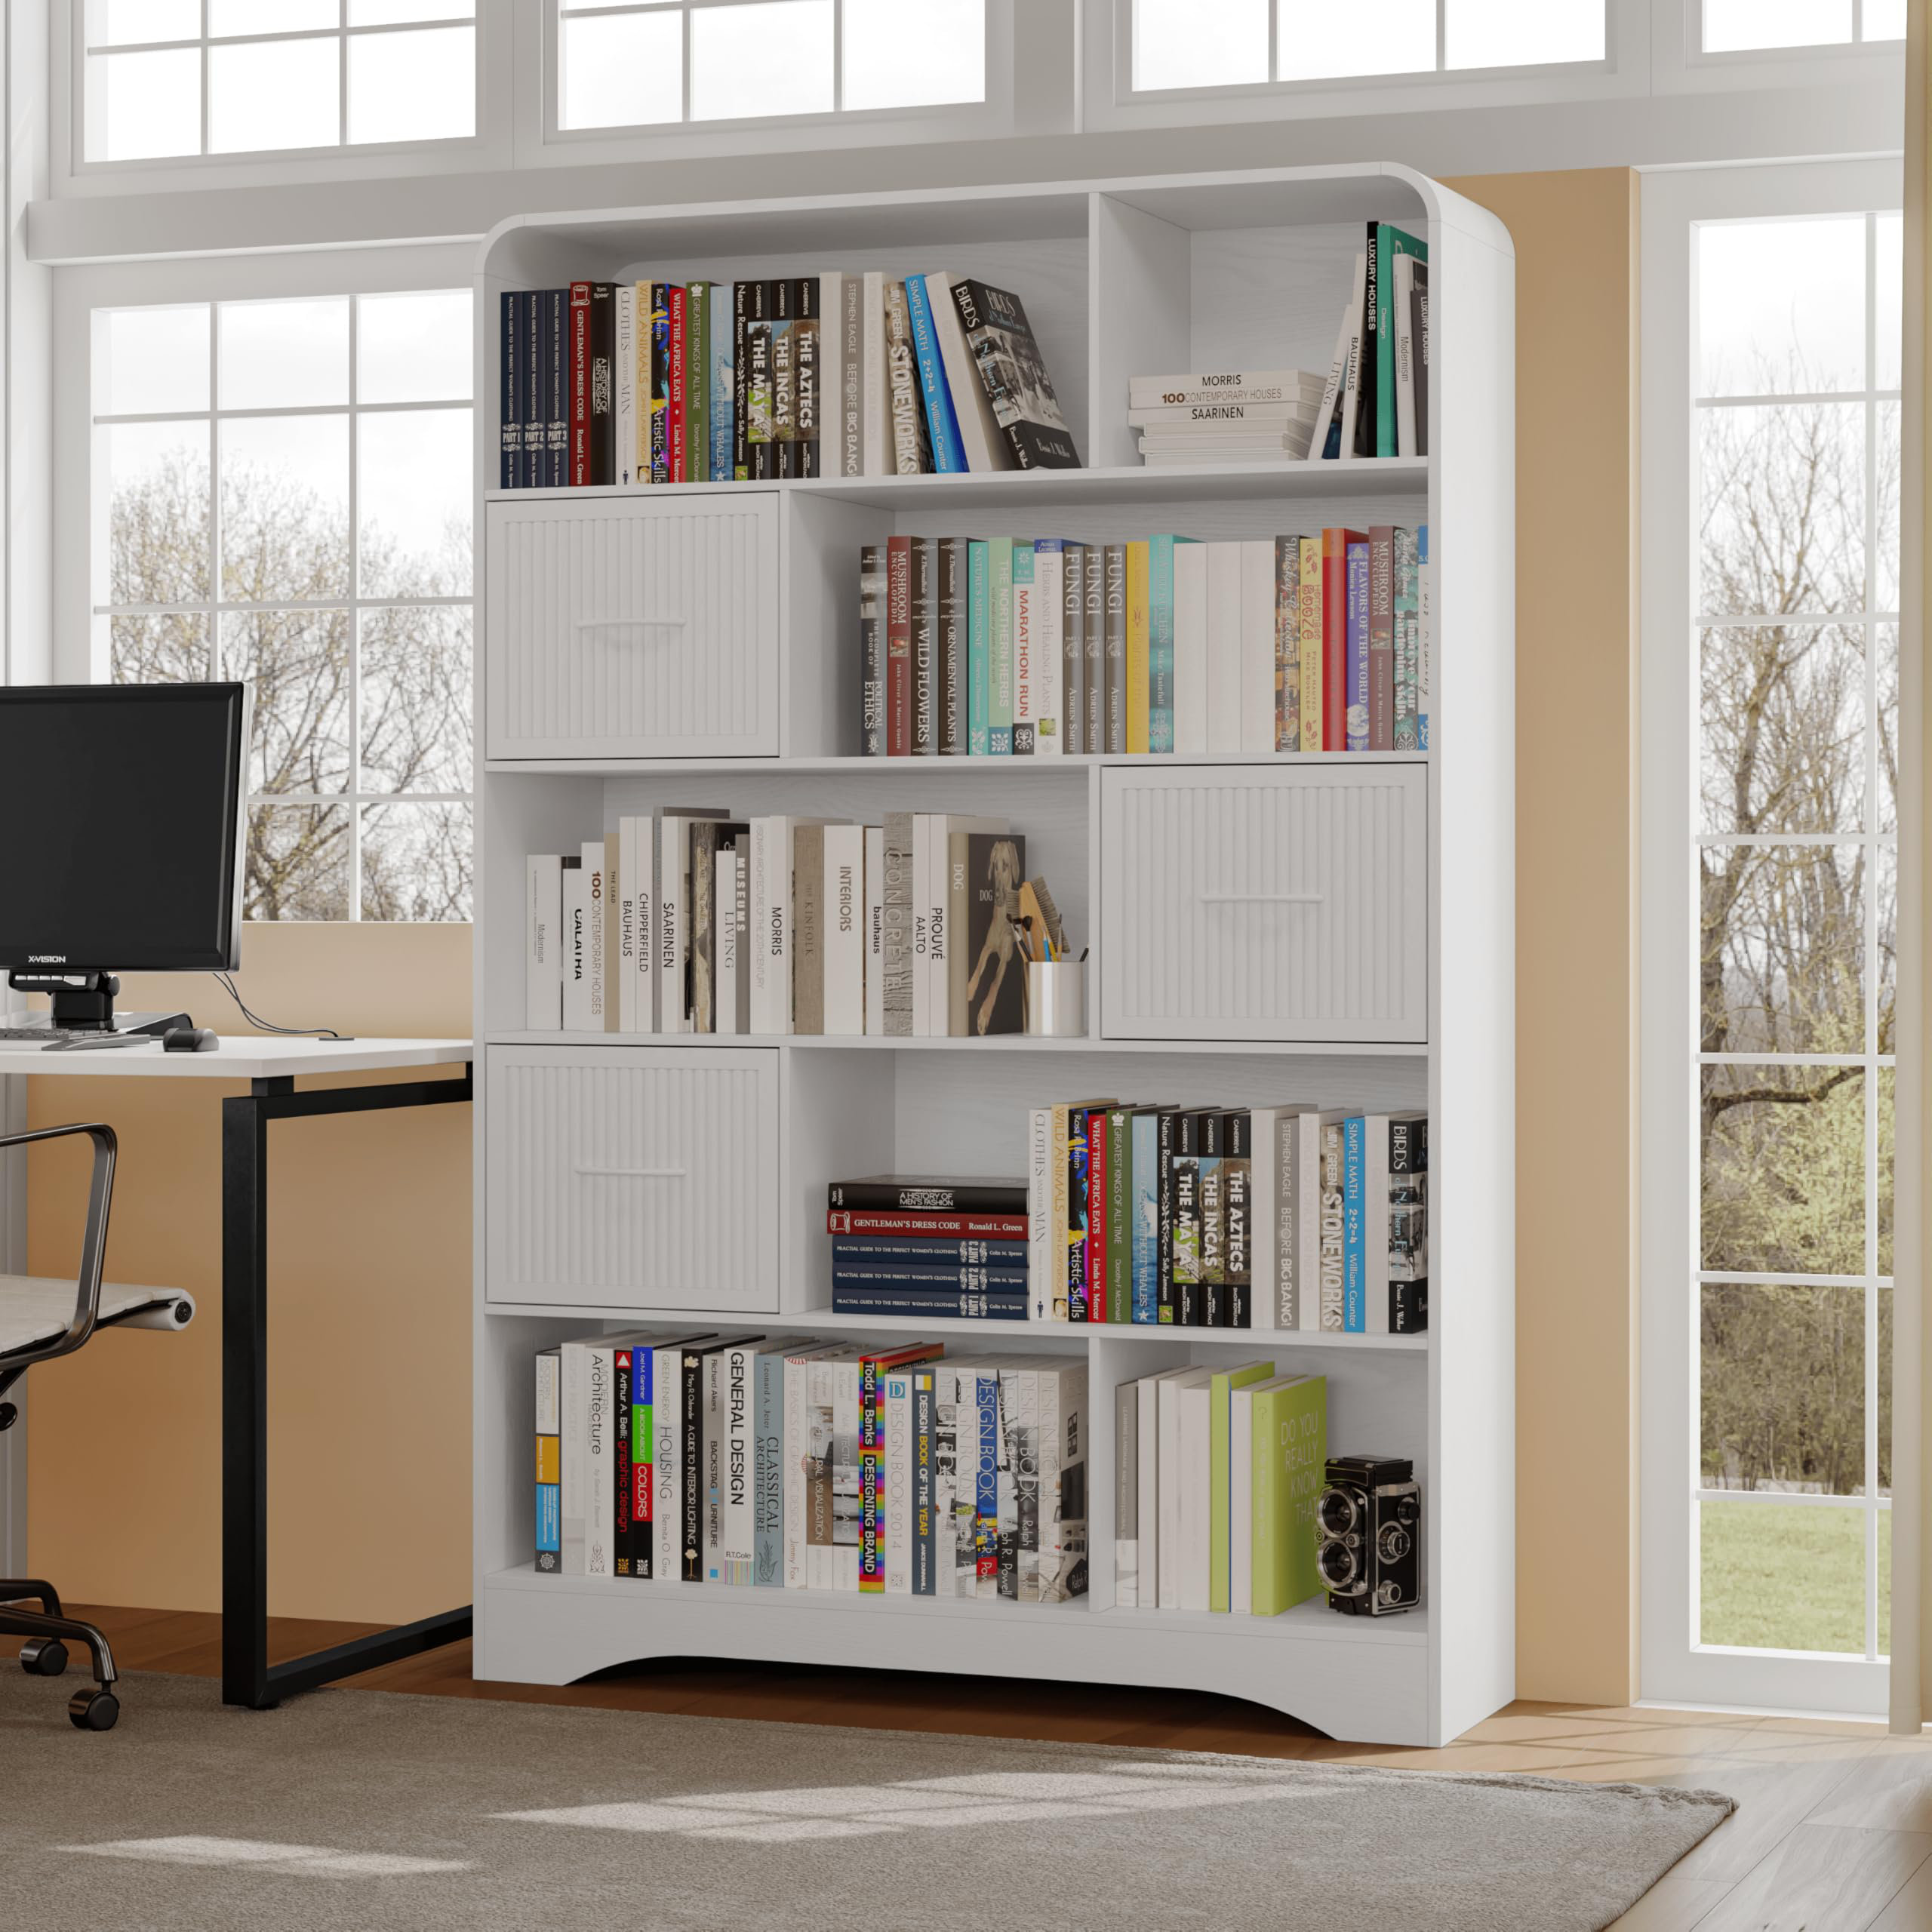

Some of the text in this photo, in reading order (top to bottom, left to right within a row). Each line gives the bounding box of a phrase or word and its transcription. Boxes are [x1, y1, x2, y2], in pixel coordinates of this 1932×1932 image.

[1367, 238, 1376, 281] LUXURY
[891, 289, 903, 340] JIM GREEN
[909, 279, 922, 317] SIMPLE
[955, 286, 980, 328] BIRDS
[737, 317, 746, 344] Rescue
[915, 319, 928, 351] MATH
[693, 363, 700, 373] OF
[753, 338, 765, 426] THE MAYA
[776, 337, 788, 425] THE INCAS
[799, 331, 811, 428] THE AZTECS
[1202, 375, 1241, 386] MORRIS
[1323, 362, 1342, 405] LIVING
[1347, 337, 1358, 391] BAUHAUS
[1400, 337, 1410, 382] Modernism
[601, 401, 607, 412] OF
[847, 364, 857, 476] BEFORE BIG BANG!
[890, 346, 917, 473] STONEWORKS
[1192, 407, 1244, 420] SAARINEN
[1251, 389, 1281, 399] HOUSES
[503, 432, 513, 443] PART
[525, 432, 544, 441] PART 2
[548, 431, 567, 441] PART 3
[931, 401, 947, 470] William Counter
[897, 552, 906, 623] MUSHROOM
[1066, 553, 1079, 616] FUNGI
[1087, 552, 1101, 616] FUNGI
[1108, 552, 1122, 615] FUNGI
[999, 561, 1009, 706] THE NORTHERN HERBS
[1359, 616, 1367, 629] OF
[1359, 632, 1367, 657] THE
[1020, 590, 1028, 716] MARATHON RUN
[864, 681, 874, 729] ETHICS
[918, 628, 929, 743] WILD FLOWERS
[948, 626, 956, 742] ORNAMENTAL PLANTS
[1359, 660, 1367, 703] WORLD
[737, 858, 745, 931] MUSEUMS
[840, 866, 851, 931] INTERIORS
[953, 863, 964, 890] DOG
[980, 890, 993, 901] DOG
[623, 901, 632, 956] BAUHAUS
[639, 894, 648, 972] CHIPPERFIELD
[663, 903, 674, 968] SAARINEN
[725, 912, 734, 968] LIVING
[771, 907, 782, 955] MORRIS
[804, 902, 814, 956] KINFOLK
[873, 906, 881, 954] bauhaus
[884, 849, 903, 989] CONCRETE
[916, 917, 925, 953] AALTO
[932, 908, 944, 959] PROUVÉ
[592, 978, 601, 1014] HOUSES
[1393, 1126, 1407, 1170] BIRDS
[1180, 1174, 1192, 1266] THE MAYA
[1204, 1174, 1217, 1266] THE INCAS
[1230, 1171, 1243, 1272] THE AZTECS
[1071, 1238, 1082, 1318] Artistic Skills
[1093, 1281, 1100, 1291] M.
[1322, 1192, 1342, 1326] STONEWORKS
[592, 1355, 603, 1454] Architecture
[620, 1404, 627, 1414] A.
[731, 1352, 743, 1505] GENERAL DESIGN
[864, 1362, 875, 1445] Todd L. Banks
[617, 1441, 629, 1487] graphic
[660, 1426, 672, 1499] HOUSING
[688, 1454, 694, 1463] TO
[919, 1395, 928, 1535] DESIGN BOOK OF THE YEAR
[979, 1377, 994, 1500] DESIGN BOOK
[638, 1466, 647, 1517] COLORS
[687, 1466, 695, 1505] INTERIOR
[756, 1436, 764, 1532] ARCHITECTURE
[767, 1436, 779, 1533] CLASSICAL
[890, 1403, 904, 1549] DESIGN BOOK 2014
[617, 1491, 629, 1532] design
[687, 1506, 695, 1544] LIGHTING
[864, 1457, 875, 1572] DESIGNING BRAND
